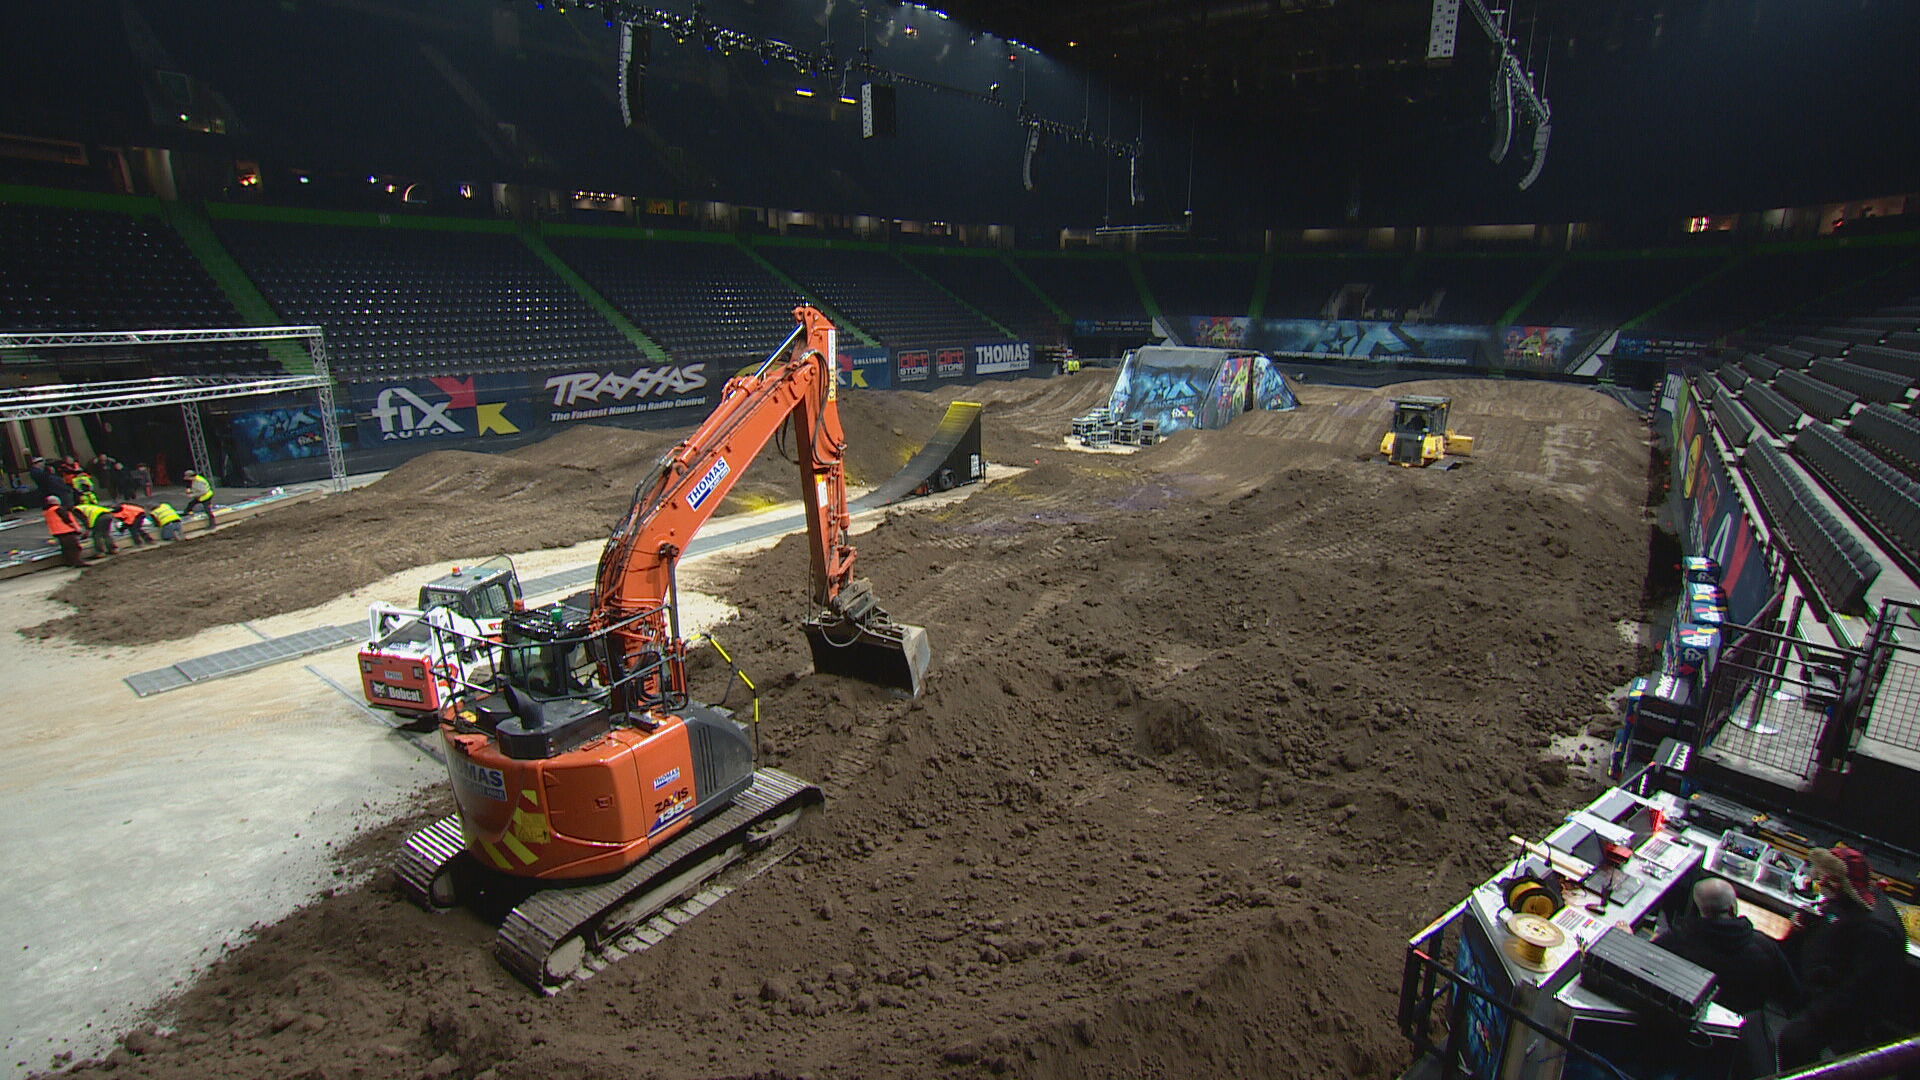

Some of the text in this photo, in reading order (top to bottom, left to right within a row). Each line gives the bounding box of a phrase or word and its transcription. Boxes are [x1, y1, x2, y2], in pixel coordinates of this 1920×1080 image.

[975, 343, 1029, 364] THOMAS
[900, 366, 928, 375] STORE
[938, 362, 963, 372] STORE
[544, 363, 707, 407] TRAXXAS
[371, 387, 465, 433] fix
[551, 397, 706, 422] The Fastest Name In Radio Control
[383, 427, 446, 440] AUTO
[687, 459, 725, 503] THOMAS
[388, 686, 421, 702] Bobcat
[655, 767, 680, 785] THOMAS
[655, 787, 689, 813] ZAXIS
